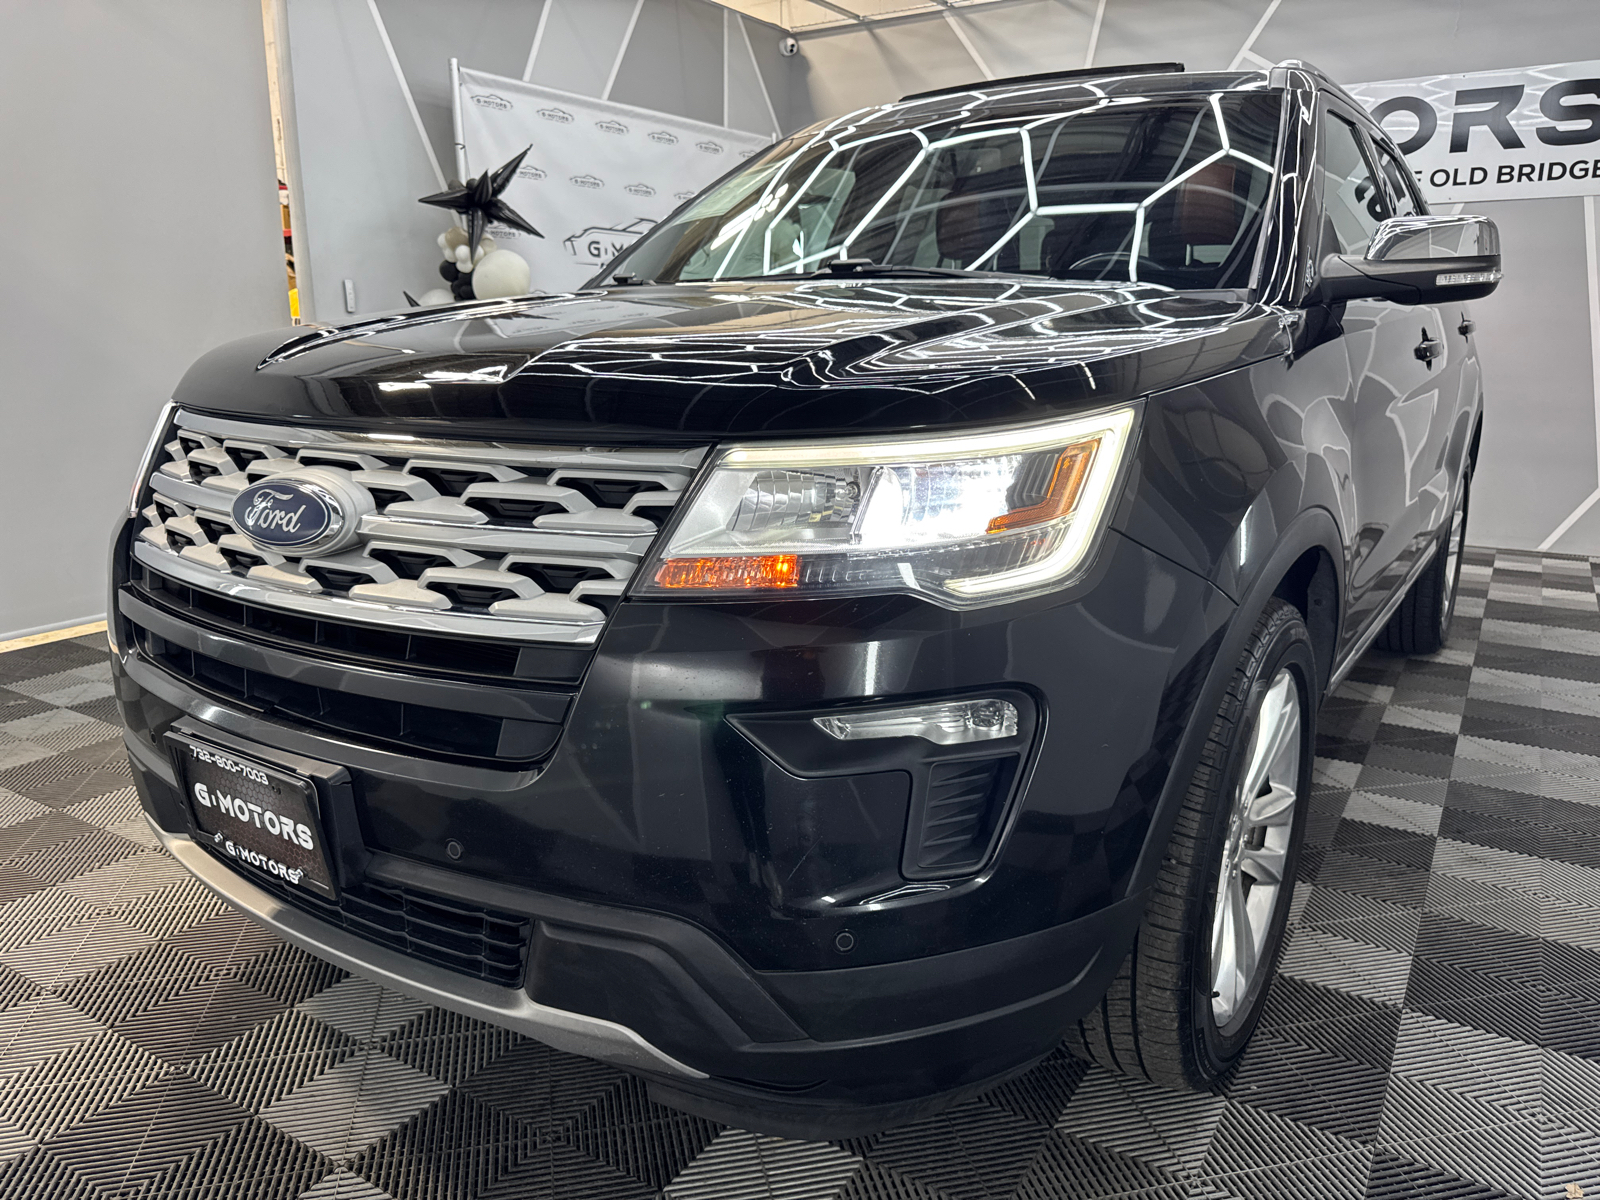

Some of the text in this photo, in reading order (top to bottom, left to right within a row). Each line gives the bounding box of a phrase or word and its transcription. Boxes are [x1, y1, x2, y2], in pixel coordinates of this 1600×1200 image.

[1429, 167, 1488, 187] OLD
[1496, 159, 1600, 184] BRIDGE
[244, 488, 307, 533] Ford
[189, 745, 269, 786] 732-800-7003
